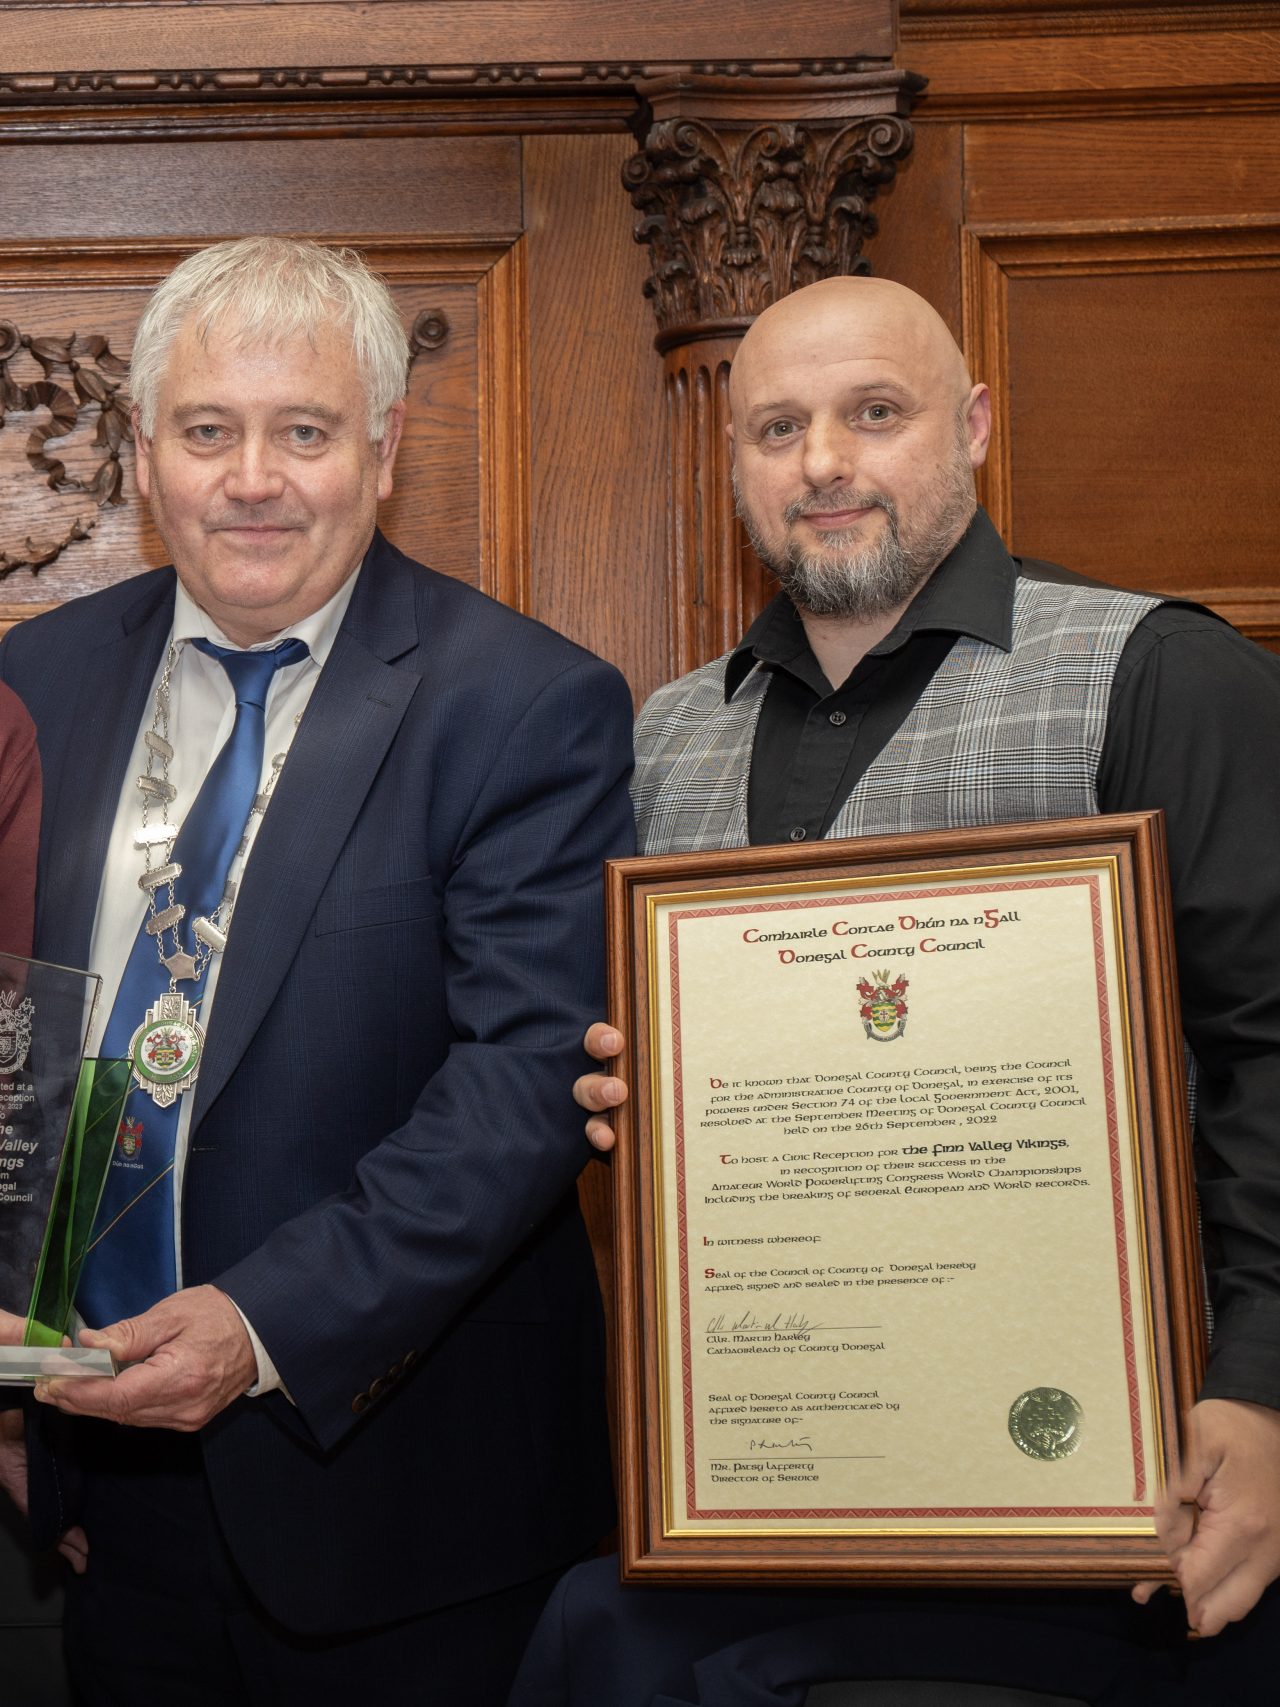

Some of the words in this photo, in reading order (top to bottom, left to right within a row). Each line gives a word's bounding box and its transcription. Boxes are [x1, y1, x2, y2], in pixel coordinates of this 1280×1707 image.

[742, 927, 828, 943] Comhairle
[831, 920, 895, 936] Contae
[897, 915, 945, 930] Dhún
[949, 917, 970, 927] na
[973, 908, 1021, 929] nGall
[777, 949, 847, 964] Donegal
[850, 943, 915, 958] County
[919, 937, 986, 953] Council
[709, 1077, 729, 1089] Be
[744, 1078, 783, 1087] known
[785, 1076, 811, 1084] that
[814, 1071, 863, 1083] Donegal
[865, 1070, 910, 1079] County
[913, 1065, 962, 1076] Council,
[964, 1065, 997, 1073] being
[1000, 1062, 1022, 1071] the
[1025, 1058, 1072, 1069] Council
[710, 1095, 731, 1104] for
[733, 1092, 754, 1101] the
[756, 1088, 844, 1100] administrative
[846, 1085, 891, 1094] County
[894, 1084, 909, 1092] of
[911, 1078, 964, 1090] Donegal,
[981, 1076, 1034, 1086] exercise
[1037, 1075, 1052, 1084] of
[705, 1106, 750, 1117] powers
[752, 1103, 788, 1112] under
[791, 1101, 837, 1110] Section
[840, 1098, 855, 1107] 74
[858, 1098, 873, 1107] of
[875, 1096, 897, 1104] the
[933, 1090, 1012, 1103] Government
[1015, 1088, 1040, 1096] Act,
[1044, 1084, 1079, 1095] 2001,
[700, 1117, 752, 1127] resolved
[770, 1115, 791, 1123] the
[794, 1111, 863, 1123] September
[865, 1108, 917, 1118] Meeting
[919, 1107, 934, 1116] of
[936, 1102, 987, 1114] Donegal
[989, 1101, 1036, 1110] County
[1039, 1096, 1087, 1107] Council
[783, 1125, 809, 1135] held
[830, 1123, 851, 1132] the
[855, 1121, 883, 1131] 26th
[886, 1118, 956, 1130] September
[966, 1114, 997, 1124] 2022
[719, 1154, 738, 1165] To
[741, 1155, 769, 1163] host
[781, 1153, 810, 1161] Civic
[812, 1150, 874, 1160] Reception
[877, 1149, 899, 1158] for
[901, 1144, 928, 1155] the
[931, 1143, 964, 1157] Finn
[967, 1140, 1012, 1152] Valley
[1015, 1138, 1070, 1150] Vikings,
[793, 1164, 862, 1175] recognition
[865, 1163, 880, 1172] of
[882, 1161, 914, 1170] their
[917, 1159, 967, 1168] success
[984, 1156, 1006, 1164] the
[711, 1182, 763, 1191] Amateur
[765, 1178, 802, 1188] World
[885, 1173, 944, 1183] Congress
[946, 1169, 985, 1179] World
[988, 1165, 1082, 1178] Championships
[758, 1192, 779, 1201] the
[782, 1190, 834, 1200] breaking
[836, 1190, 851, 1199] of
[854, 1186, 902, 1197] several
[967, 1182, 990, 1191] and
[993, 1180, 1032, 1190] World
[1035, 1178, 1090, 1188] records.
[703, 1235, 714, 1246] In
[717, 1237, 764, 1246] witness
[704, 1267, 731, 1279] Seal
[733, 1271, 746, 1279] of
[748, 1269, 767, 1277] the
[770, 1267, 810, 1276] Council
[812, 1268, 825, 1276] of
[827, 1266, 868, 1275] County
[870, 1266, 884, 1274] of
[889, 1262, 934, 1272] Donegal
[936, 1262, 976, 1270] hereby
[746, 1282, 780, 1291] signed
[804, 1279, 840, 1288] sealed
[855, 1278, 875, 1286] the
[877, 1277, 929, 1287] presence
[931, 1276, 945, 1284] of
[706, 1345, 781, 1354] Cathaoirleach
[783, 1346, 796, 1354] of
[798, 1344, 839, 1353] County
[841, 1341, 885, 1352] Donegal
[733, 1334, 772, 1342] Martin
[708, 1393, 732, 1402] Seal
[734, 1395, 747, 1403] of
[749, 1392, 793, 1402] Donegal
[795, 1391, 836, 1401] County
[838, 1390, 879, 1399] Council
[805, 1402, 883, 1411] authenticated
[885, 1402, 900, 1411] by
[730, 1417, 781, 1426] signature
[710, 1463, 731, 1471] Mr.
[733, 1462, 764, 1473] Patsy
[766, 1461, 814, 1471] Lafferty
[710, 1474, 759, 1482] Director
[761, 1475, 775, 1484] of
[777, 1473, 819, 1481] Service
